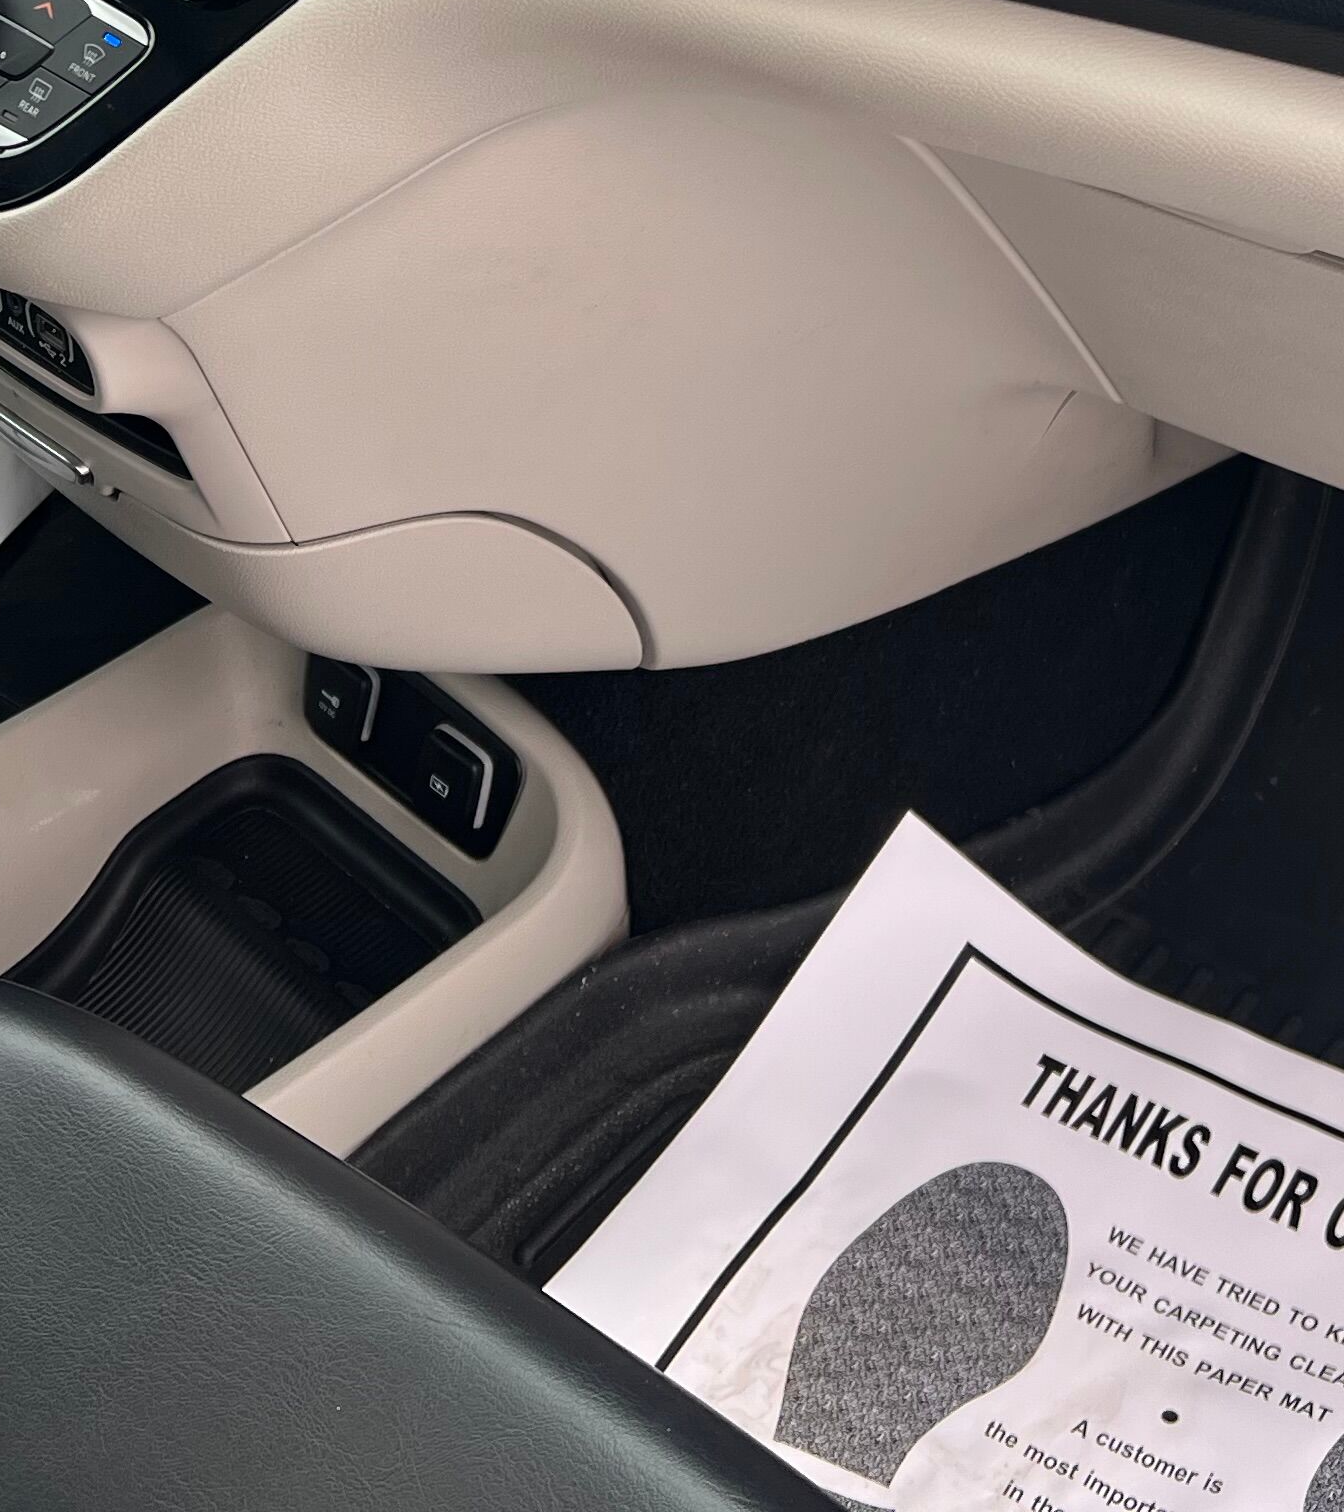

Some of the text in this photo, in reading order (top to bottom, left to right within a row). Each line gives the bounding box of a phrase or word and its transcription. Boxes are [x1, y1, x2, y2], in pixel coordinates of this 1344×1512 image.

[67, 62, 97, 84] FRONT
[17, 99, 41, 118] REAR
[7, 315, 25, 335] AUX
[58, 353, 68, 368] 2
[1020, 1053, 1212, 1180] THANKS
[1210, 1143, 1319, 1232] FOR
[1107, 1225, 1145, 1256] WE
[1146, 1245, 1211, 1287] HAVE
[1215, 1275, 1281, 1317] TRIED
[1288, 1307, 1319, 1332] TO
[1086, 1261, 1148, 1304] YOUR
[1153, 1296, 1283, 1362] CARPETING
[1076, 1303, 1334, 1424] WITH THIS PAPER MAT
[984, 1420, 1019, 1449] the
[1023, 1444, 1081, 1481] most
[1070, 1419, 1224, 1495] A customer is
[1002, 1480, 1025, 1504] in
